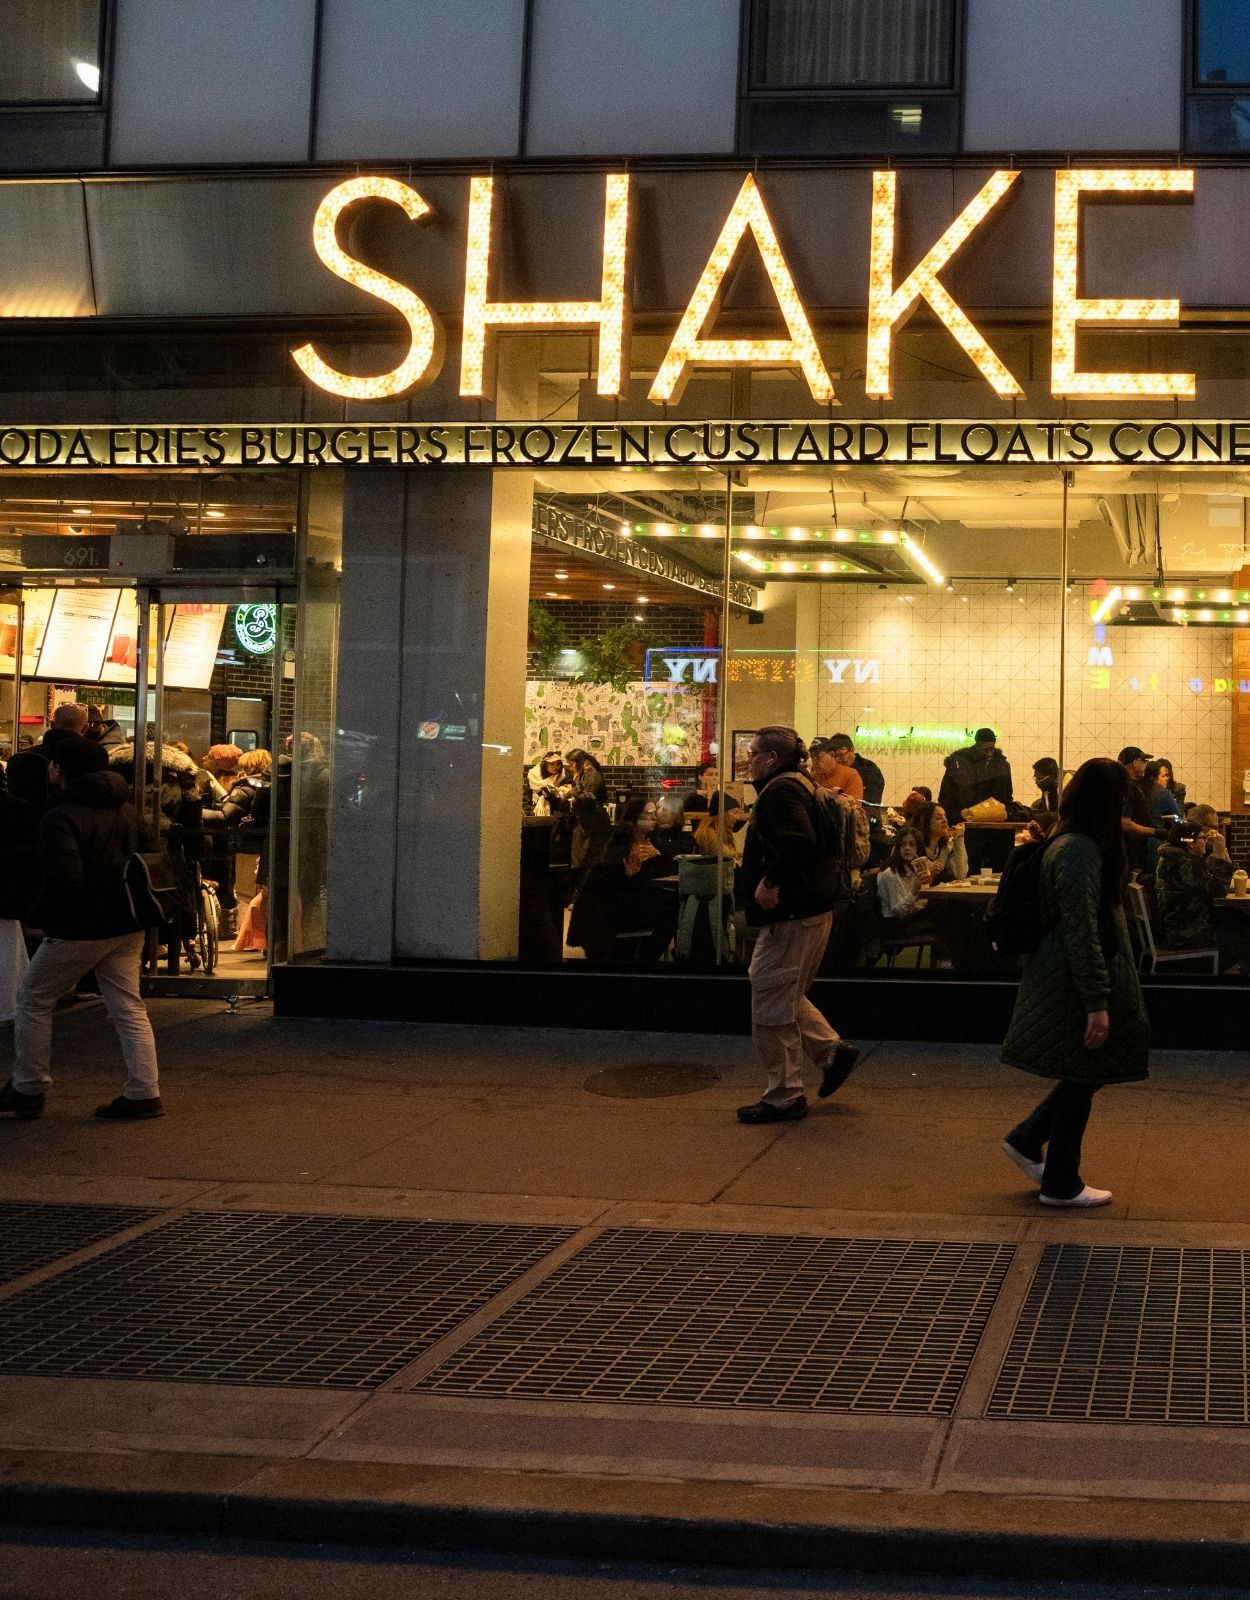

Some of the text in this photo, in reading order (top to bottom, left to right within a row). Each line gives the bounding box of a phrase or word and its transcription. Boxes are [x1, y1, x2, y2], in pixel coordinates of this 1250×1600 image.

[291, 170, 1197, 403] SHAKE
[108, 427, 224, 465] FRIES
[240, 426, 448, 465] BURGERS
[464, 423, 650, 464] FROZEN
[664, 422, 890, 463] CUSTARD
[906, 422, 1095, 463] FLOATS
[80, 689, 113, 698] PICK UP
